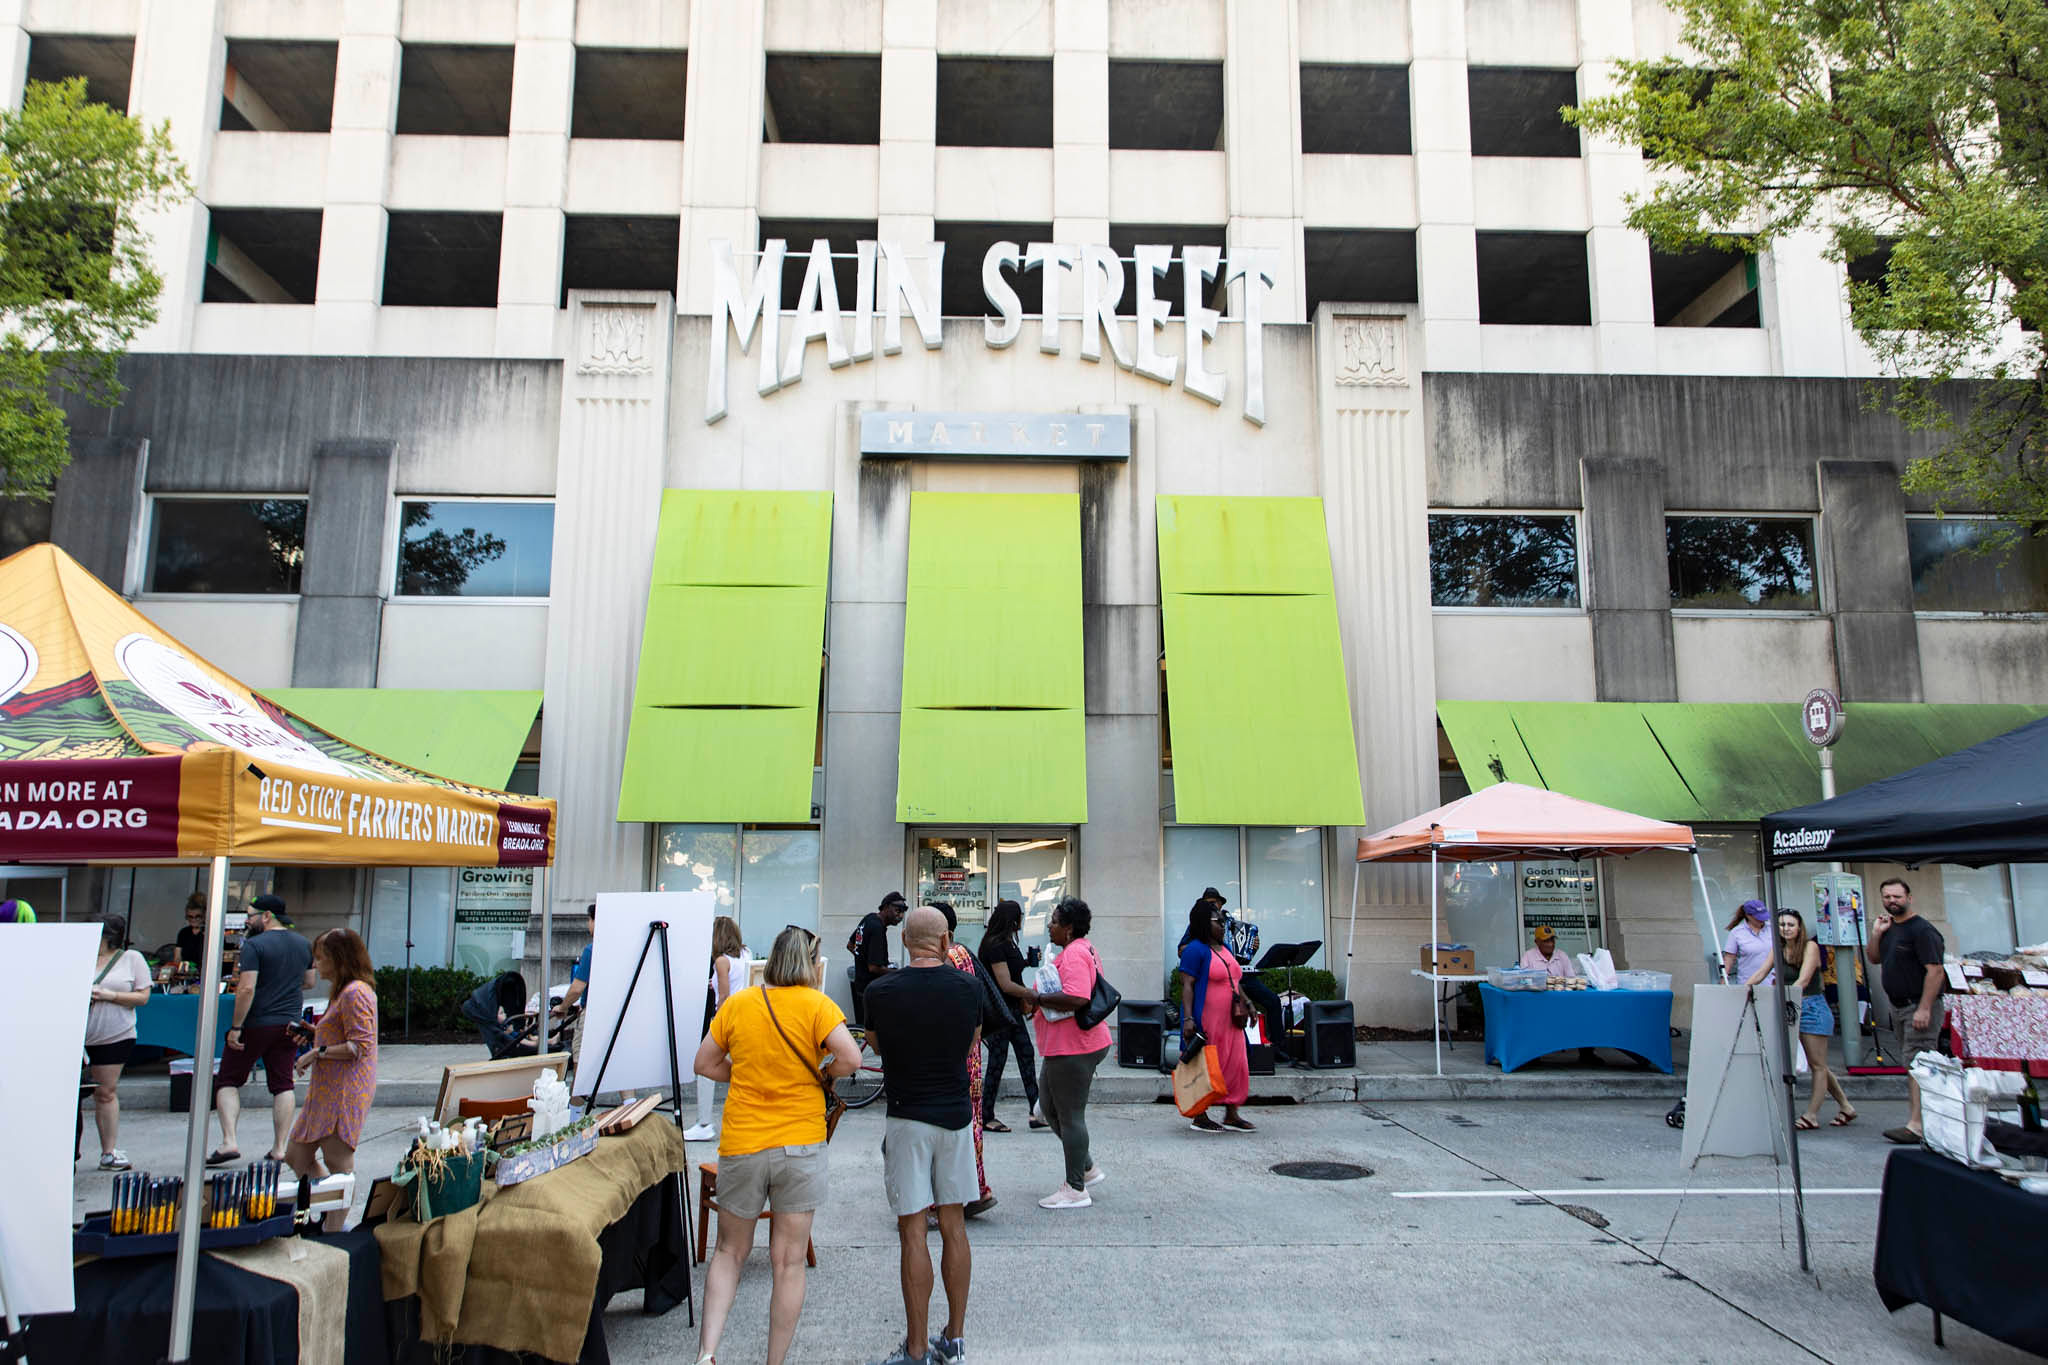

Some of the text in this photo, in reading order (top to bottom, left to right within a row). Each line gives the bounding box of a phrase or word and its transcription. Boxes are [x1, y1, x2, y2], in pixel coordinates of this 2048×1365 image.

[705, 238, 1280, 427] MAIN STREET
[887, 420, 1105, 447] MARKET
[0, 780, 133, 802] N MORE AT
[258, 776, 494, 847] RED STICK FARMERS MARKET
[502, 837, 545, 851] BREADA.ORG
[1773, 827, 1832, 848] Academy
[462, 871, 534, 886] Growing
[1526, 867, 1590, 877] Good Things
[1524, 876, 1594, 892] Growing
[922, 898, 984, 910] Gwing
